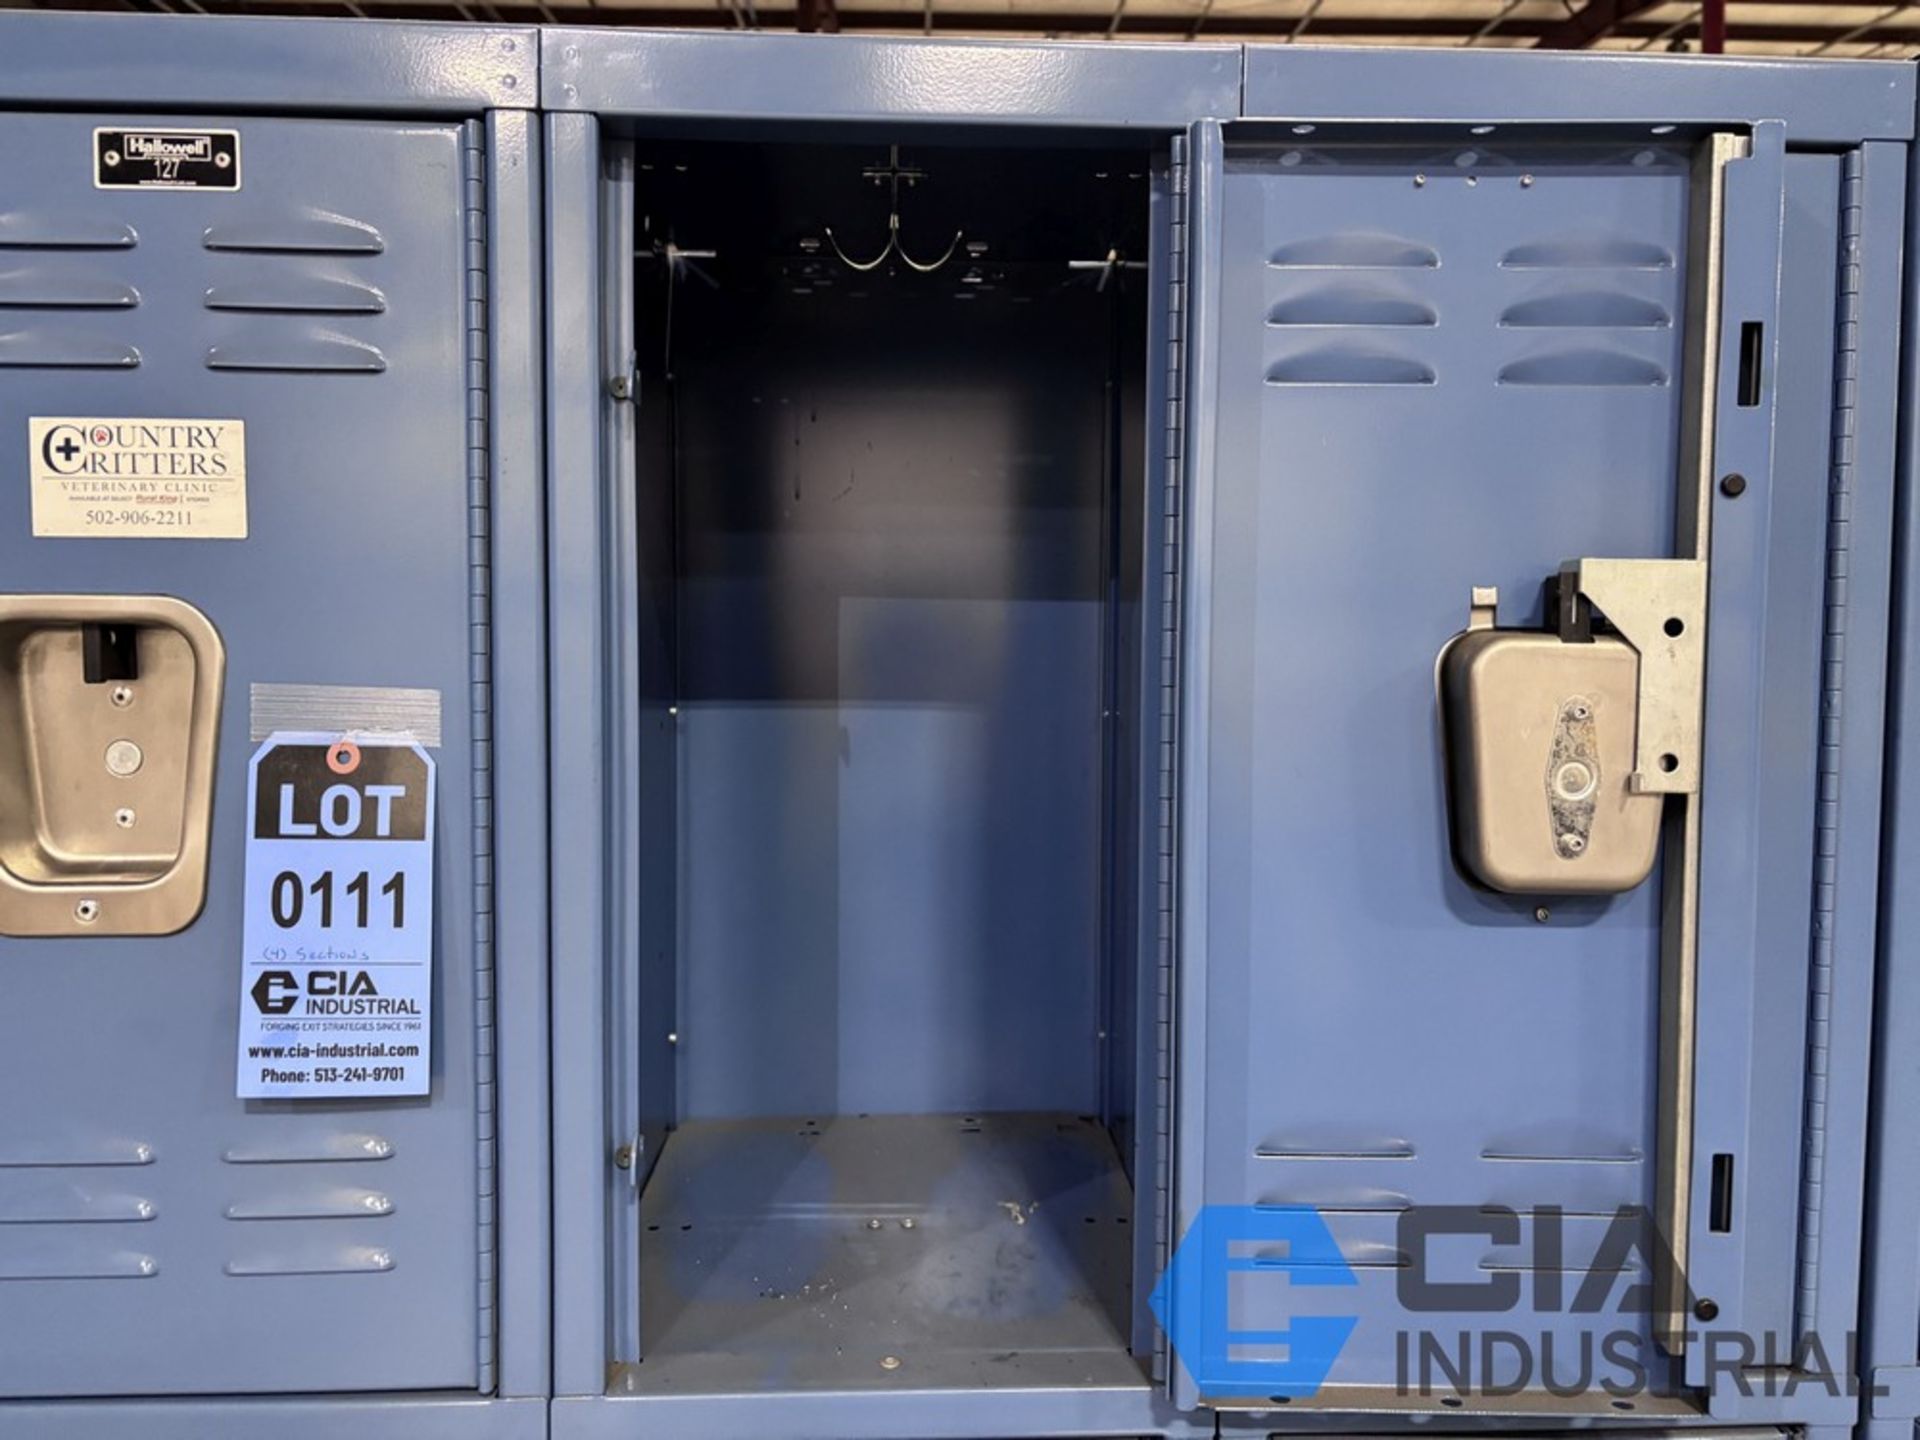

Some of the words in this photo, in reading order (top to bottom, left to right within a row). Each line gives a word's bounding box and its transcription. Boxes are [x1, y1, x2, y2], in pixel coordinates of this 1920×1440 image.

[154, 159, 181, 178] 127
[42, 424, 224, 456] COUNTRY
[42, 444, 228, 475] CRITTERS
[61, 481, 158, 492] VETERINARY
[164, 482, 218, 493] CLINIC
[85, 510, 192, 525] 502-906-2211
[278, 783, 406, 836] LOT
[271, 870, 405, 928] 0111
[263, 947, 287, 961] (4)
[307, 971, 379, 995] CIA
[306, 999, 421, 1015] INDUSTRIAL
[261, 1022, 300, 1032] FORGING
[302, 1022, 321, 1032] EXIT
[322, 1022, 375, 1032] STRATEGIES
[376, 1022, 401, 1032] SINCE
[249, 1043, 419, 1058] www.cia-industrial.com
[261, 1068, 310, 1083] Phone:
[314, 1066, 404, 1082] 513-241-9701
